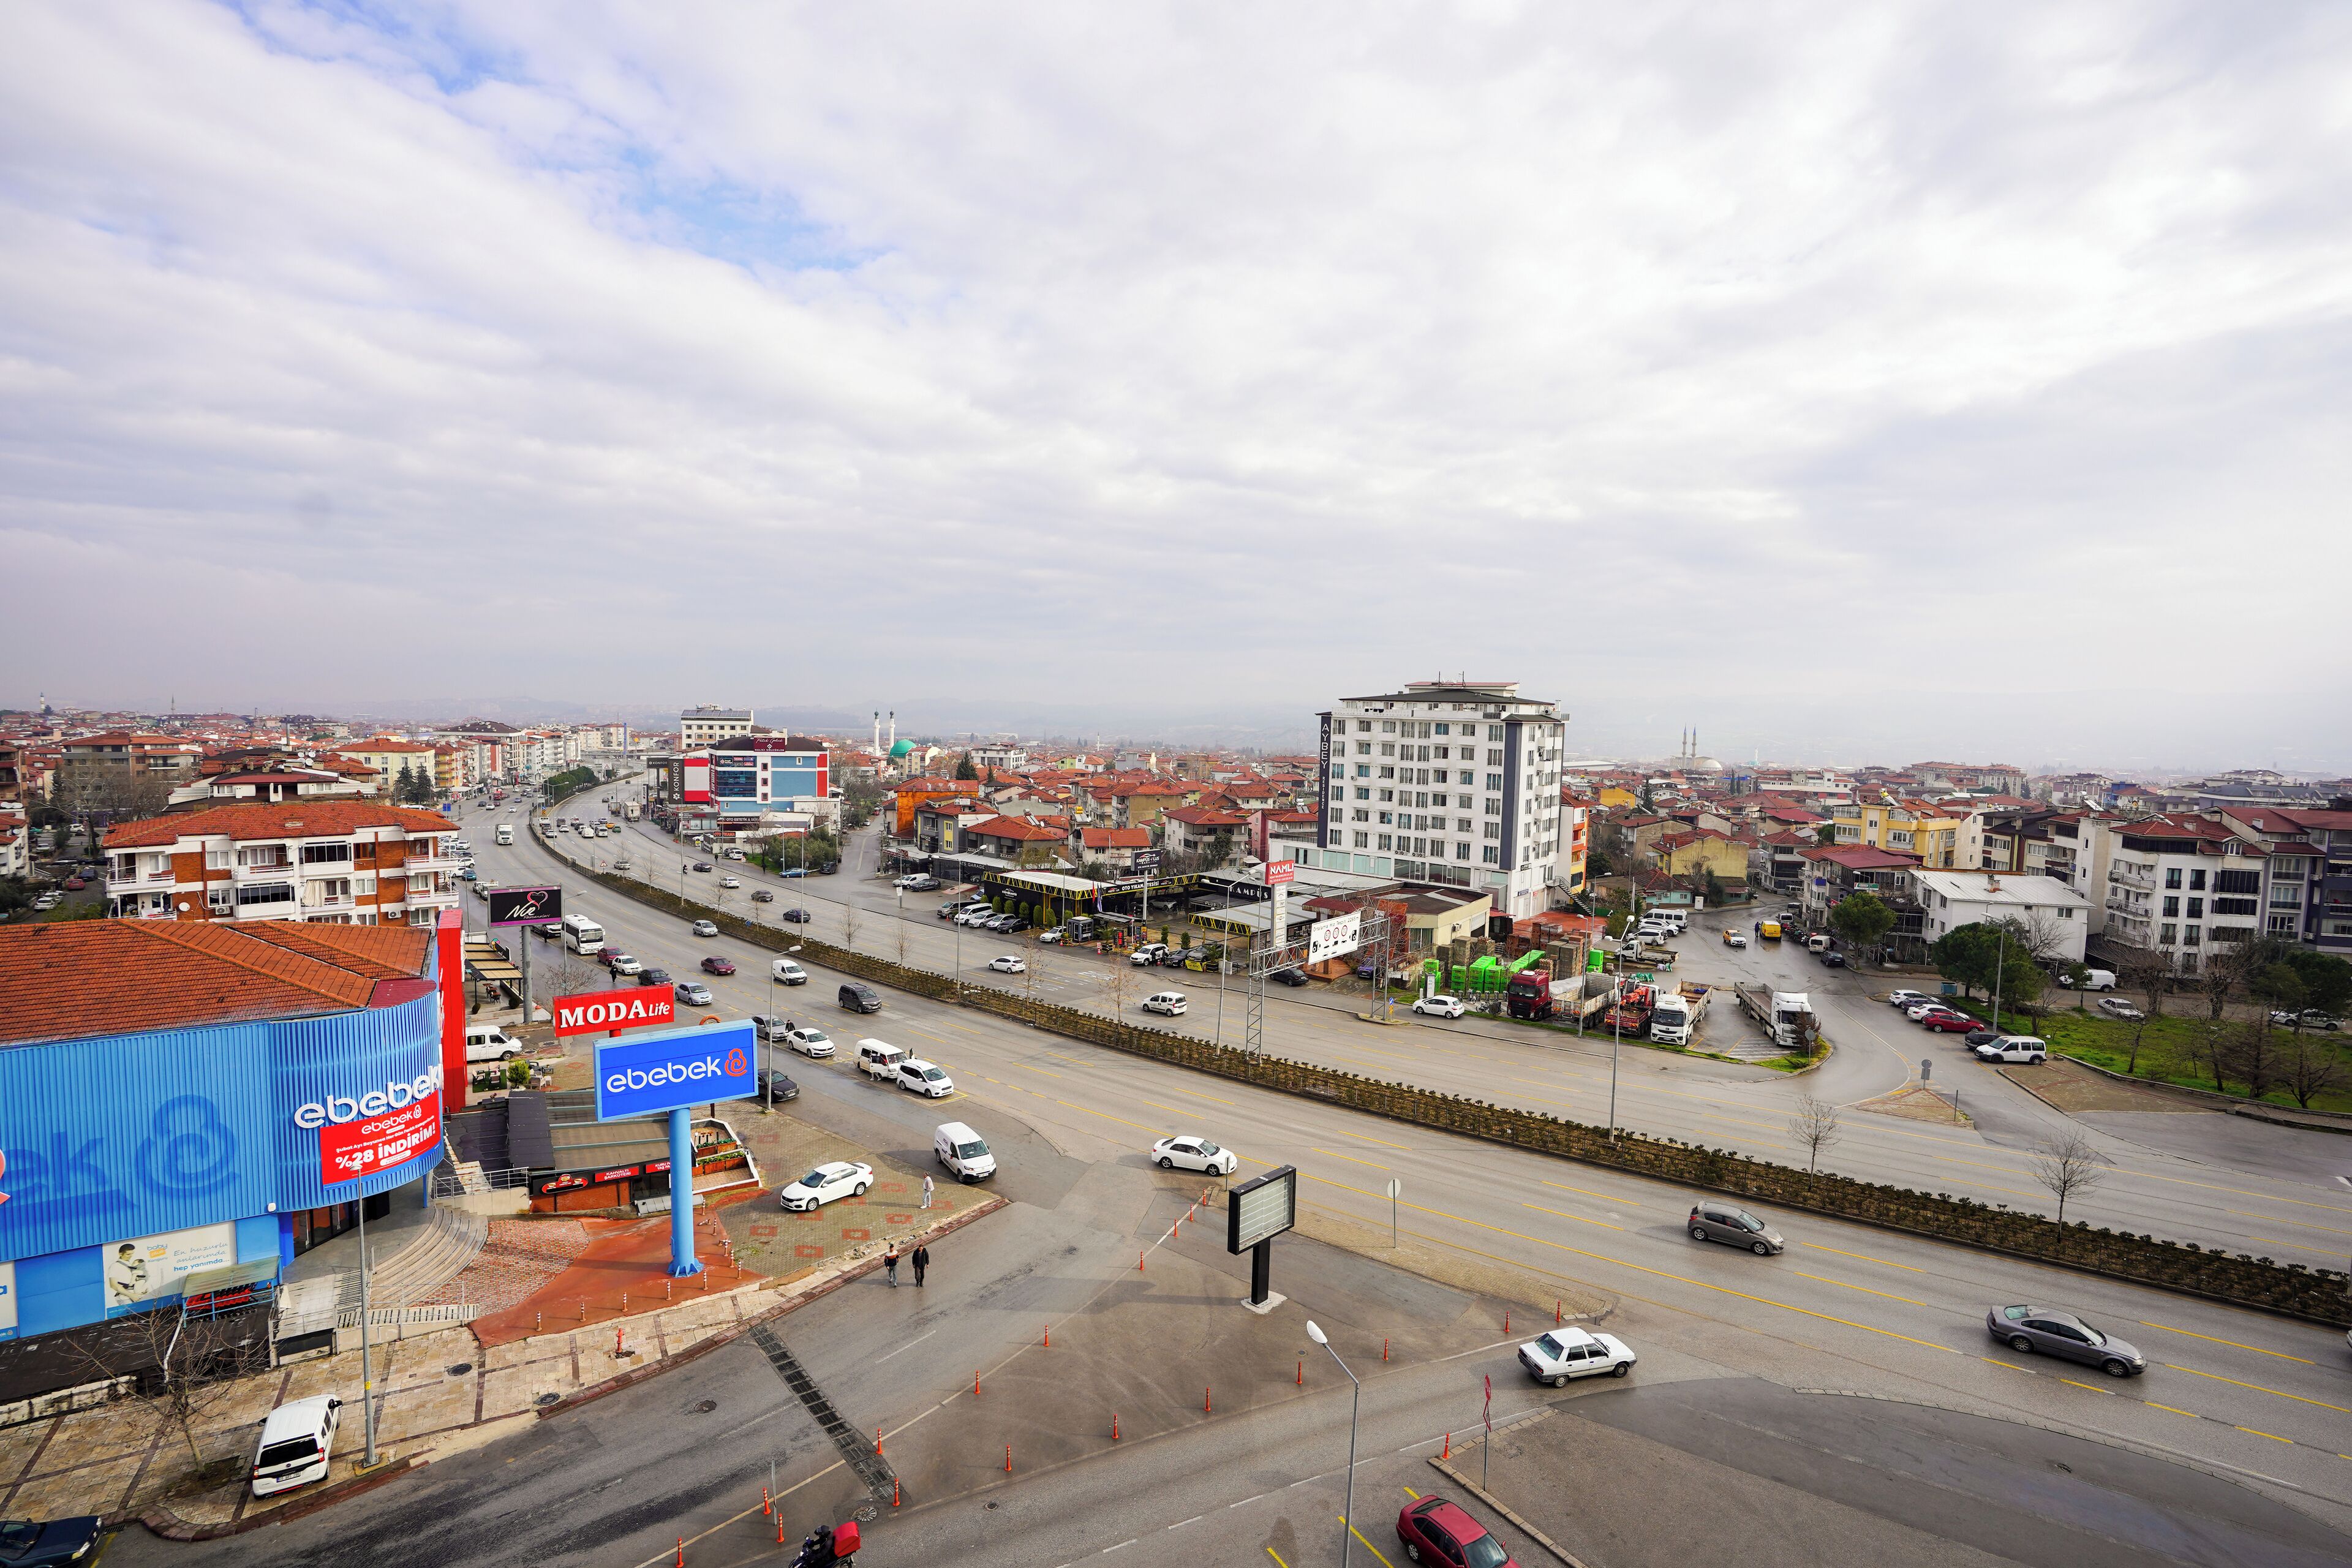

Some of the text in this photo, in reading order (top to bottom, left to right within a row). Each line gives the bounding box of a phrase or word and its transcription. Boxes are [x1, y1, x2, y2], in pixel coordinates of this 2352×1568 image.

[1321, 723, 1330, 769] AYBEY
[1270, 863, 1294, 875] NAMLI
[560, 999, 671, 1028] MODA Life
[606, 1055, 722, 1093] ebebek
[294, 1065, 440, 1129] ebebek
[361, 1110, 413, 1134] ebebek
[335, 1149, 375, 1169] %28
[378, 1121, 436, 1159] İNDİRİM!
[336, 1145, 353, 1153] Şubat
[363, 1137, 386, 1147] Boyunca
[190, 1242, 228, 1253] huzurlu
